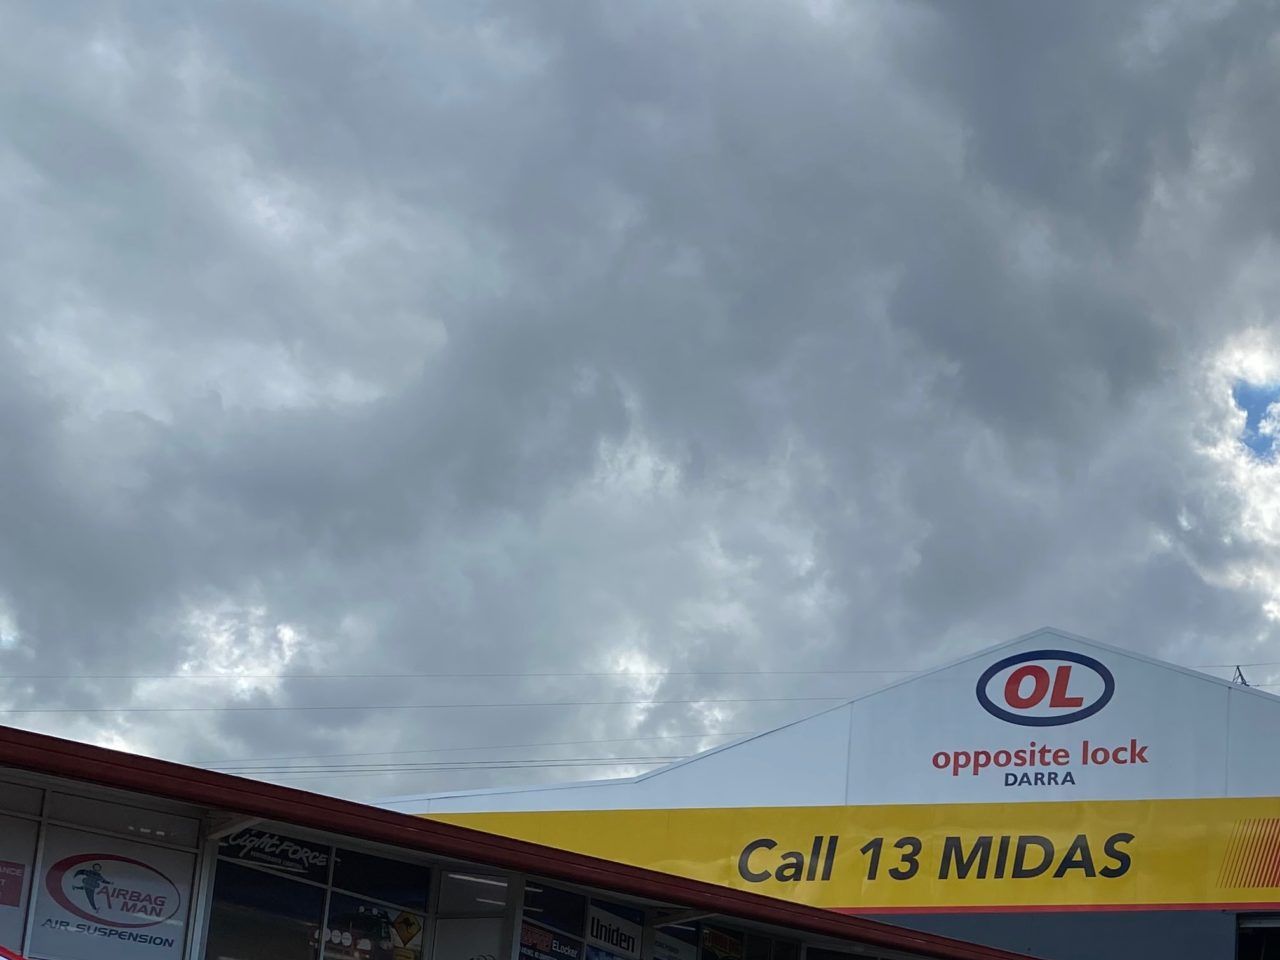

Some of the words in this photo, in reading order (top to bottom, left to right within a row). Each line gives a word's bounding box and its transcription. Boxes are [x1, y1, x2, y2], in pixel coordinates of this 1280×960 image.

[1004, 665, 1084, 709] OL
[932, 741, 1070, 777] opposite
[1082, 739, 1148, 766] lock
[1004, 771, 1076, 787] DARRA
[738, 835, 839, 882] Call
[860, 837, 922, 881] 13
[938, 833, 1135, 880] MIDAS
[96, 886, 167, 909] AIRBAG
[120, 902, 163, 917] MAN
[42, 919, 70, 931] AIR
[76, 924, 174, 948] SUSPENSION
[591, 917, 635, 953] Uniden
